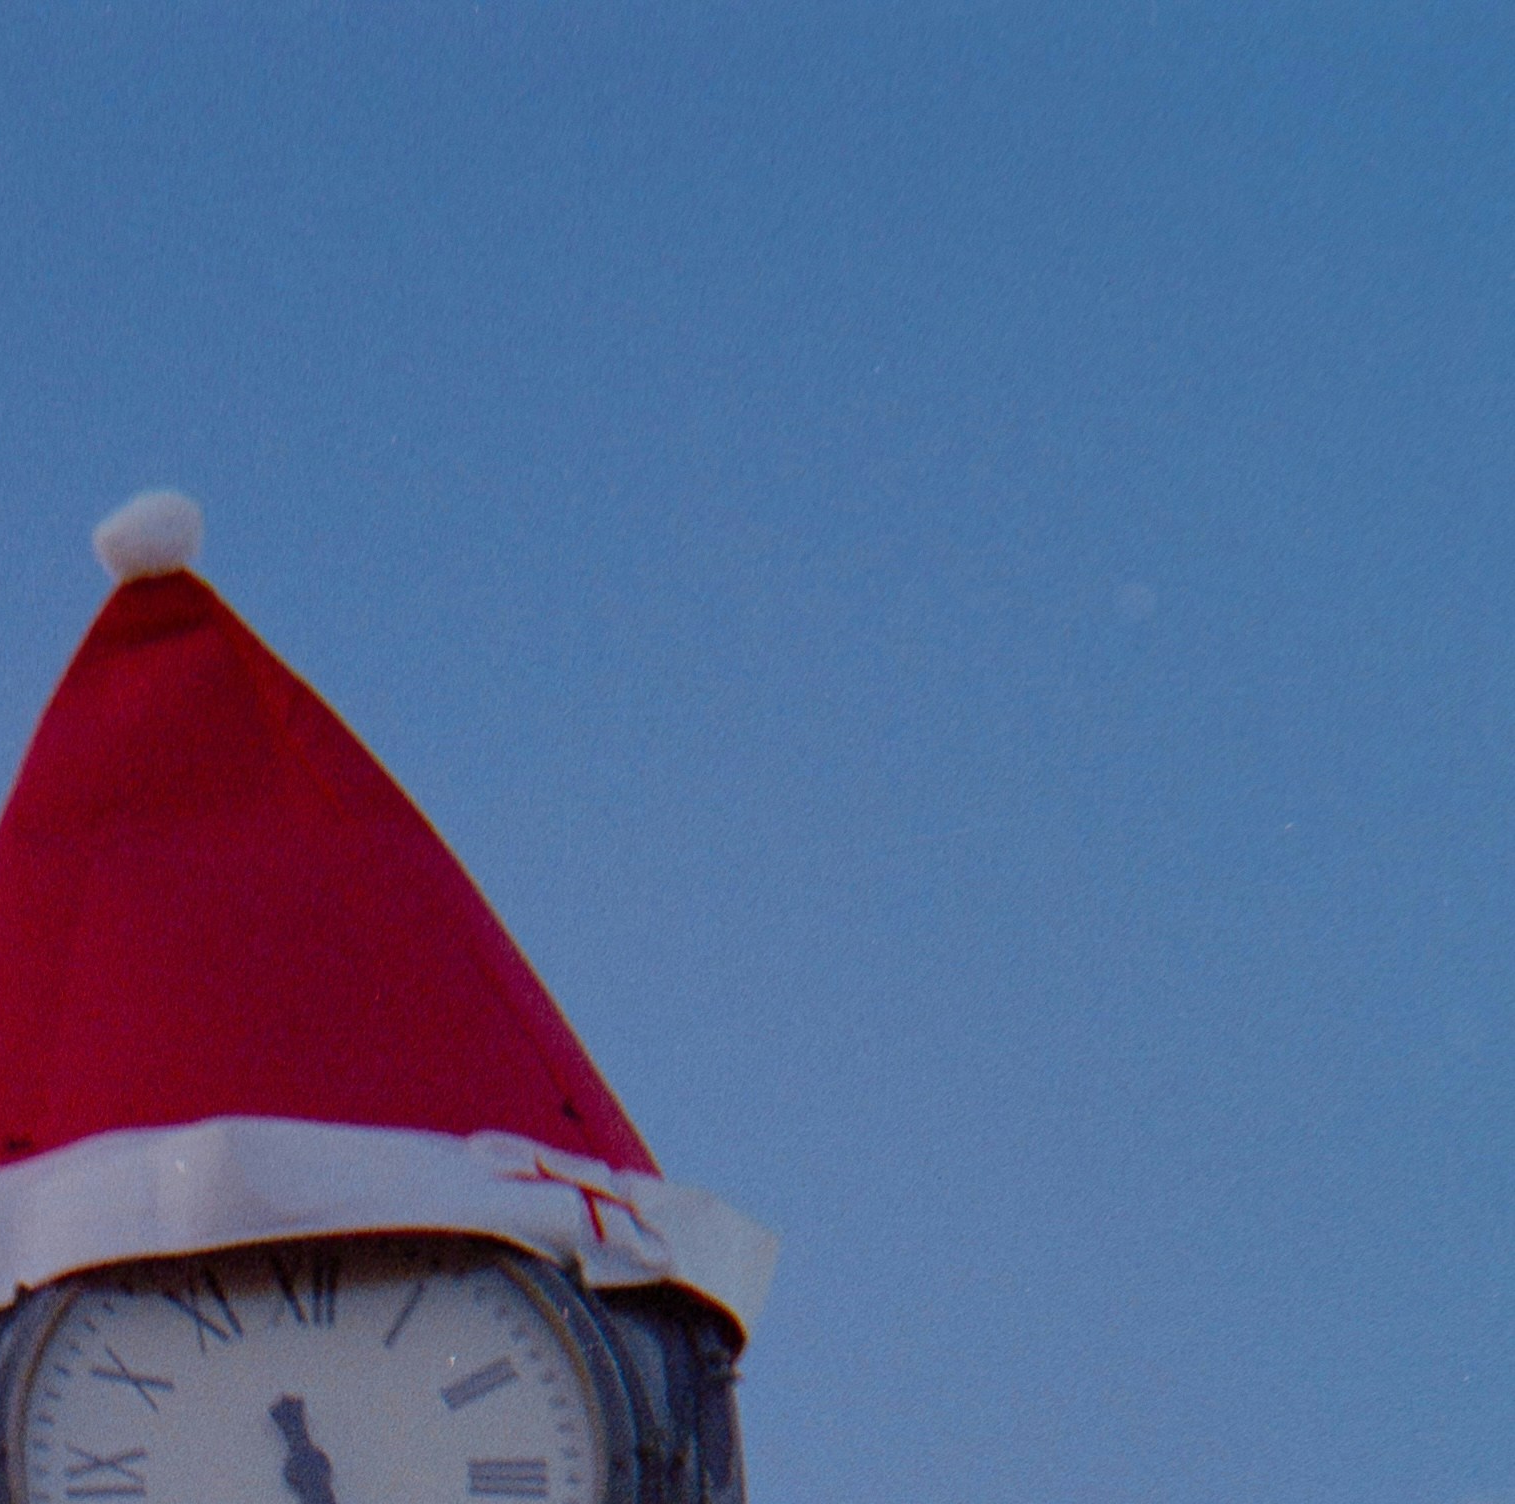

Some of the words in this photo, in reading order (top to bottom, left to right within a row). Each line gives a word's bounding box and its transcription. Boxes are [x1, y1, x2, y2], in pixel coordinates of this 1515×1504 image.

[90, 1345, 175, 1412] X
[65, 1443, 147, 1497] IX
[468, 1459, 548, 1497] III
